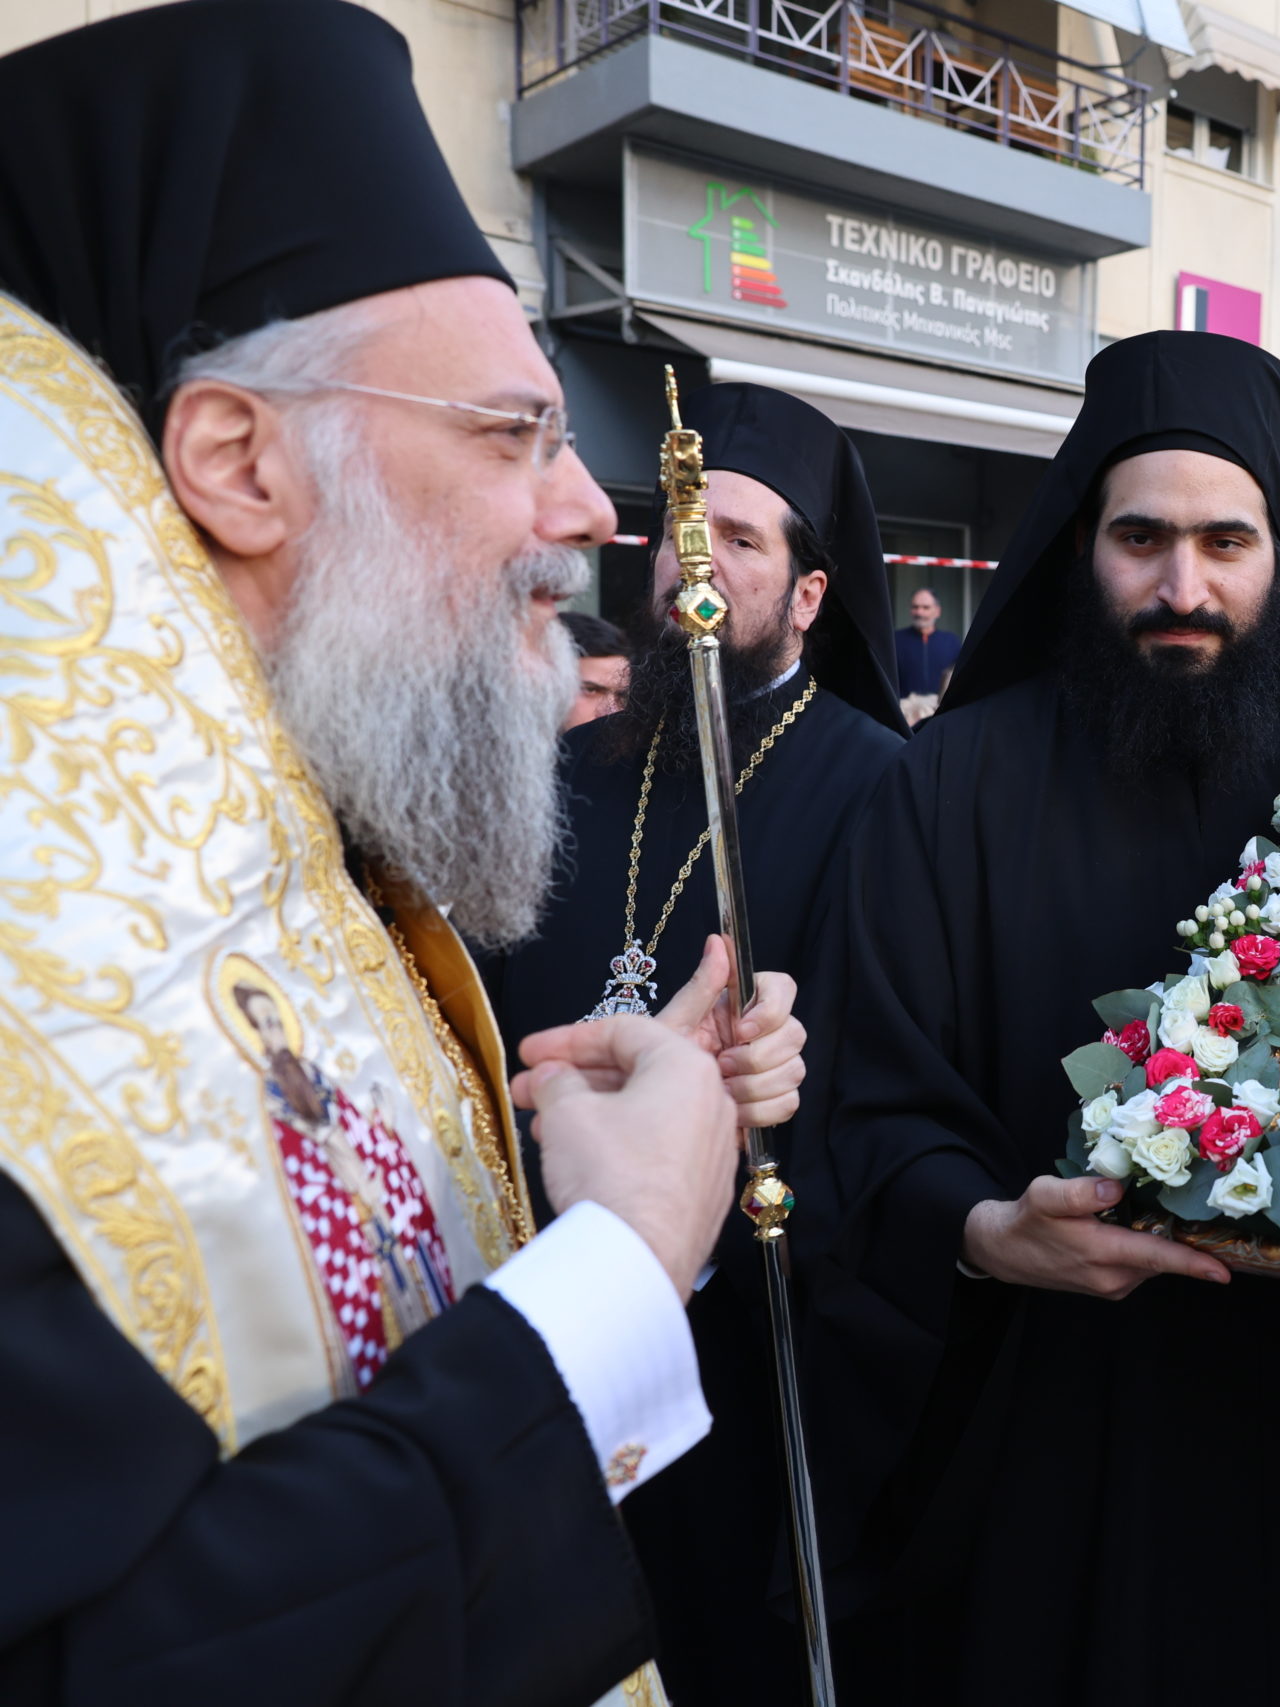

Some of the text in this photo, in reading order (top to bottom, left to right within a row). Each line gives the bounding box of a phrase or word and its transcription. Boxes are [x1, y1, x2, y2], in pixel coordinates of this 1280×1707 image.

[825, 213, 1057, 299] ΤΕΧΝΙΚΟ ΓΡΑΦΕΙΟ
[825, 257, 926, 306] Σκανδάλης
[952, 287, 1051, 334] Παναγιώτης
[826, 292, 901, 332] Πολιτικός
